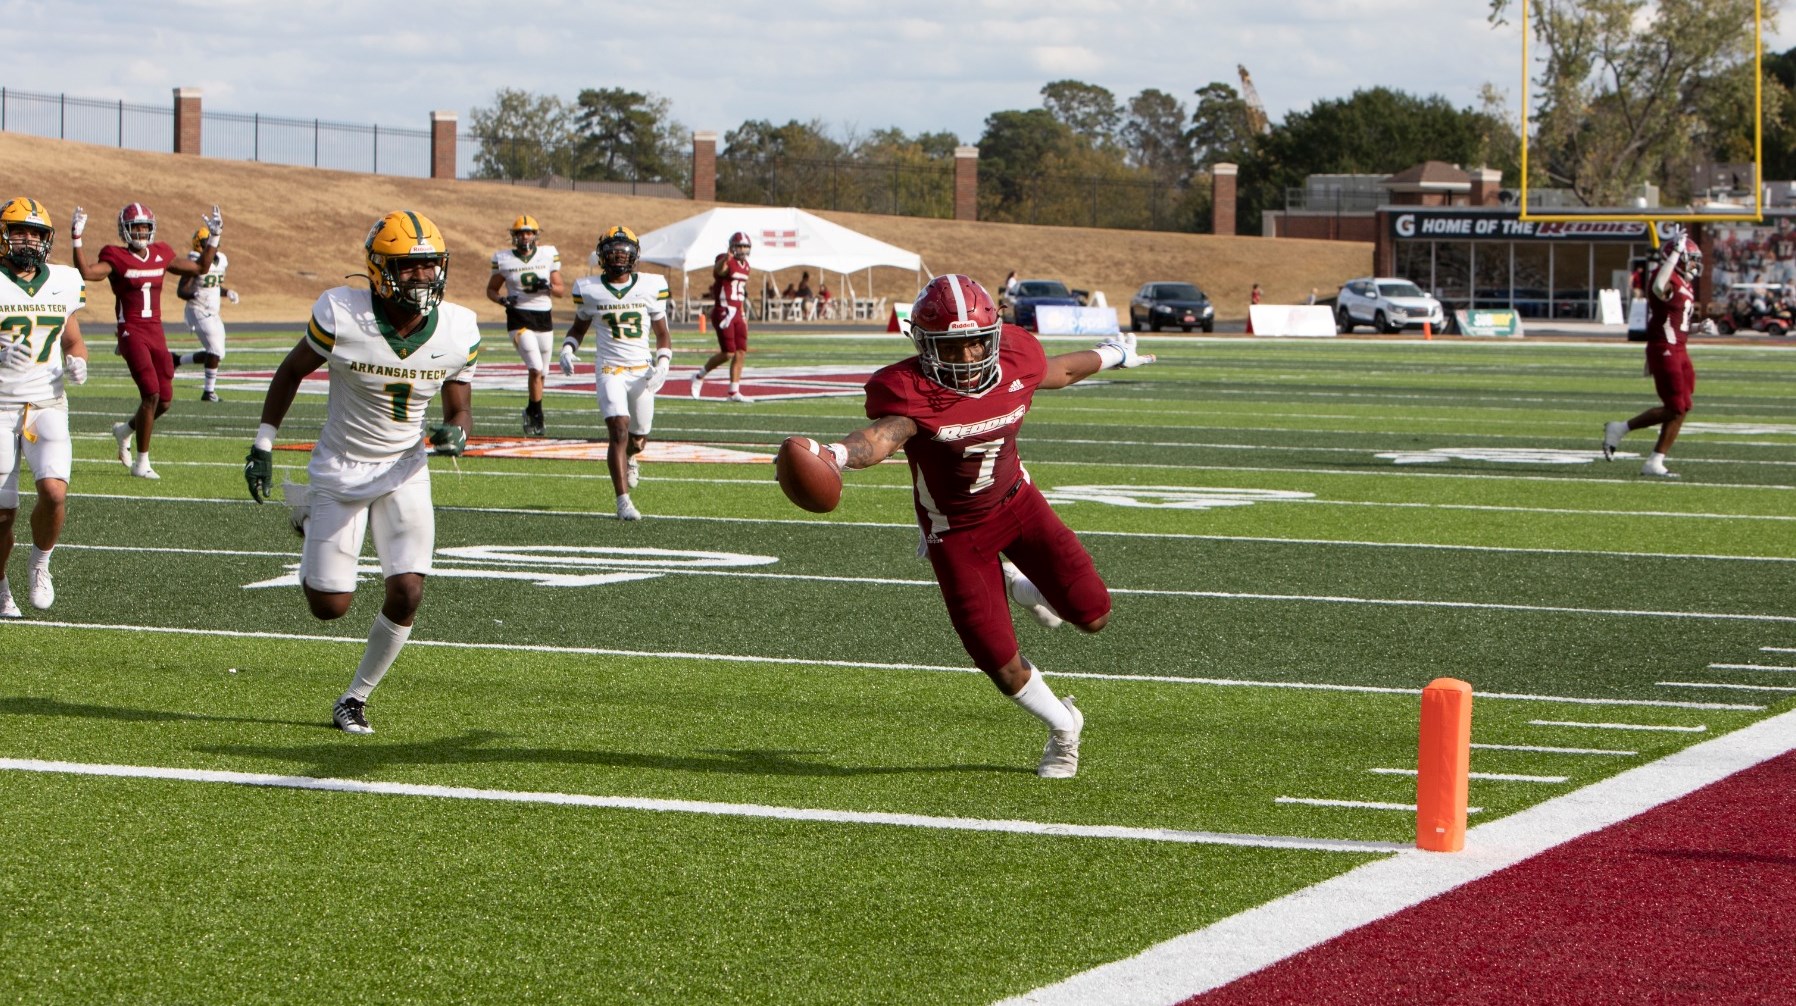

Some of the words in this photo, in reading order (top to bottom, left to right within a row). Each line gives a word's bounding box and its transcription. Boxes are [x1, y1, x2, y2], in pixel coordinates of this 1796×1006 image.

[1395, 214, 1415, 237] G
[1421, 219, 1471, 234] HOME
[1475, 220, 1499, 235] OF
[1501, 220, 1535, 235] THE
[1535, 221, 1647, 237] REDDIES
[0, 304, 46, 313] ARKANSAS
[47, 304, 67, 313] TECH
[141, 282, 153, 318] 1
[0, 316, 66, 363] 37
[602, 311, 644, 340] 13
[349, 361, 417, 379] ARKANSAS
[419, 369, 447, 380] TECH
[384, 382, 414, 422] 1
[930, 404, 1025, 442] REDDIES
[963, 437, 1005, 494] 7
